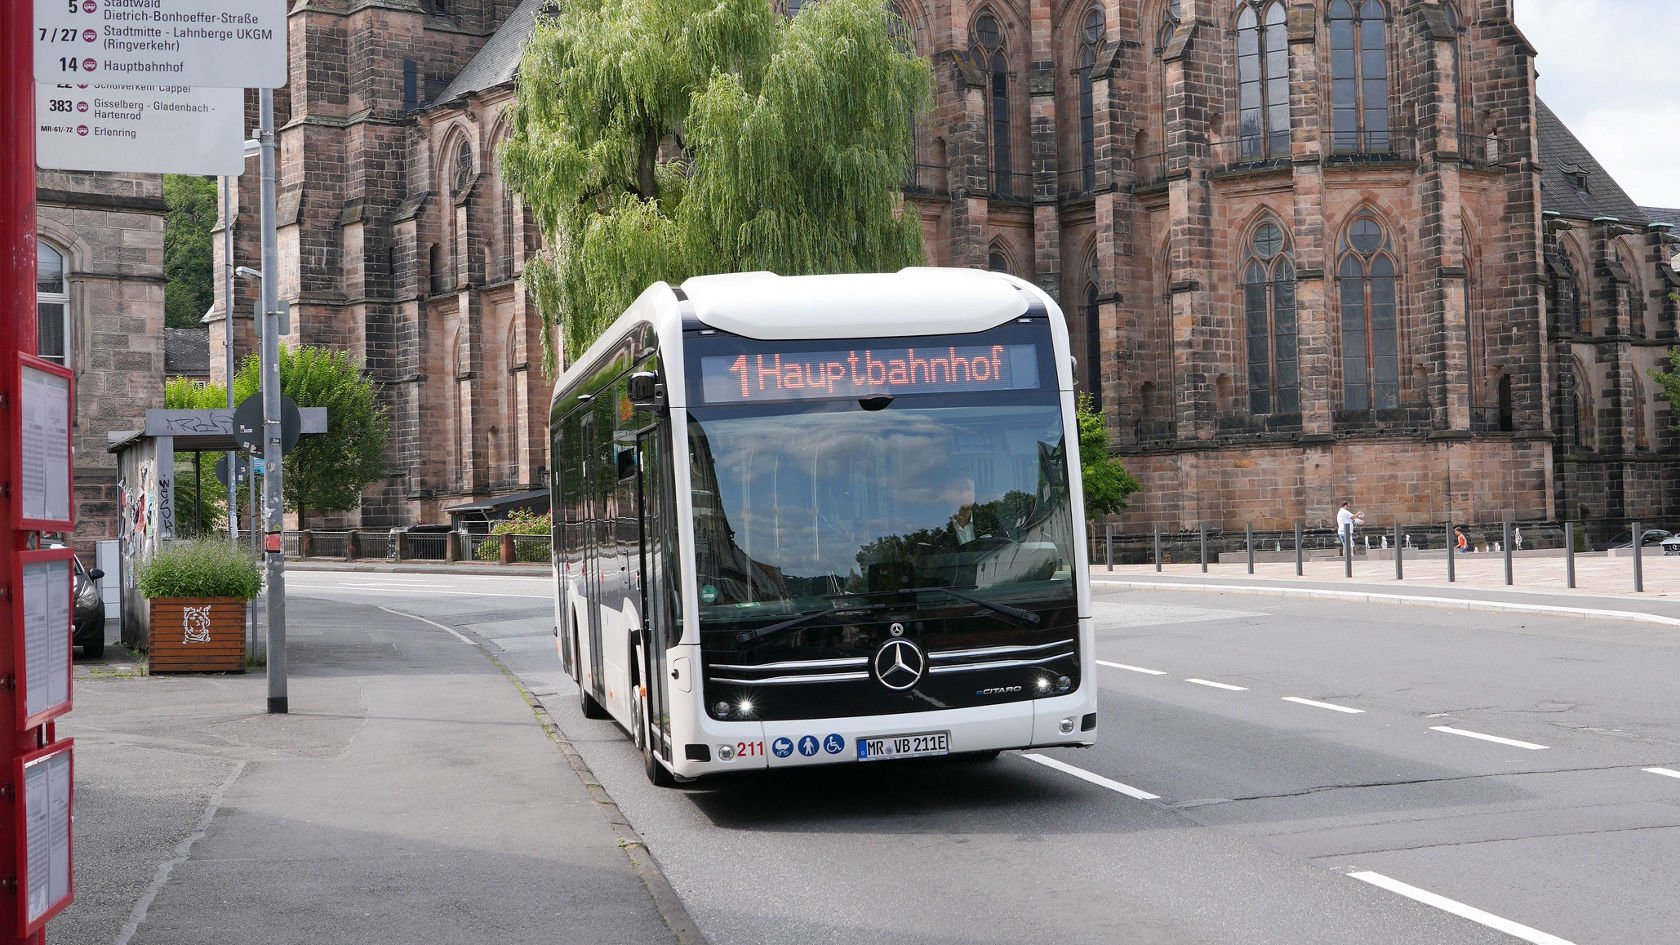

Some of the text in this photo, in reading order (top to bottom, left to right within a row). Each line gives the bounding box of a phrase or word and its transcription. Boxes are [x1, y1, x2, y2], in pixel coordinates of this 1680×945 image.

[68, 0, 78, 13] 5
[104, 10, 258, 24] Dietrich-Bonhoeffer-Straße
[39, 28, 46, 41] 7
[51, 28, 57, 43] /
[61, 29, 78, 41] 27
[104, 25, 161, 37] Stadtmitte
[174, 27, 233, 41] Lahnberge
[237, 29, 273, 40] UKGM
[104, 39, 180, 52] (Ringverkehr)
[60, 57, 184, 73] 14 Hauptbahnhof
[49, 100, 72, 112] 383
[94, 98, 144, 111] Gisselberg
[154, 101, 208, 112] Gladenbach
[94, 110, 141, 120] Hartenrod
[94, 127, 136, 139] Erlenring
[728, 345, 1004, 397] 1 Hauptbahnhof
[737, 741, 763, 756] 211
[868, 736, 946, 755] MR VB 211E
